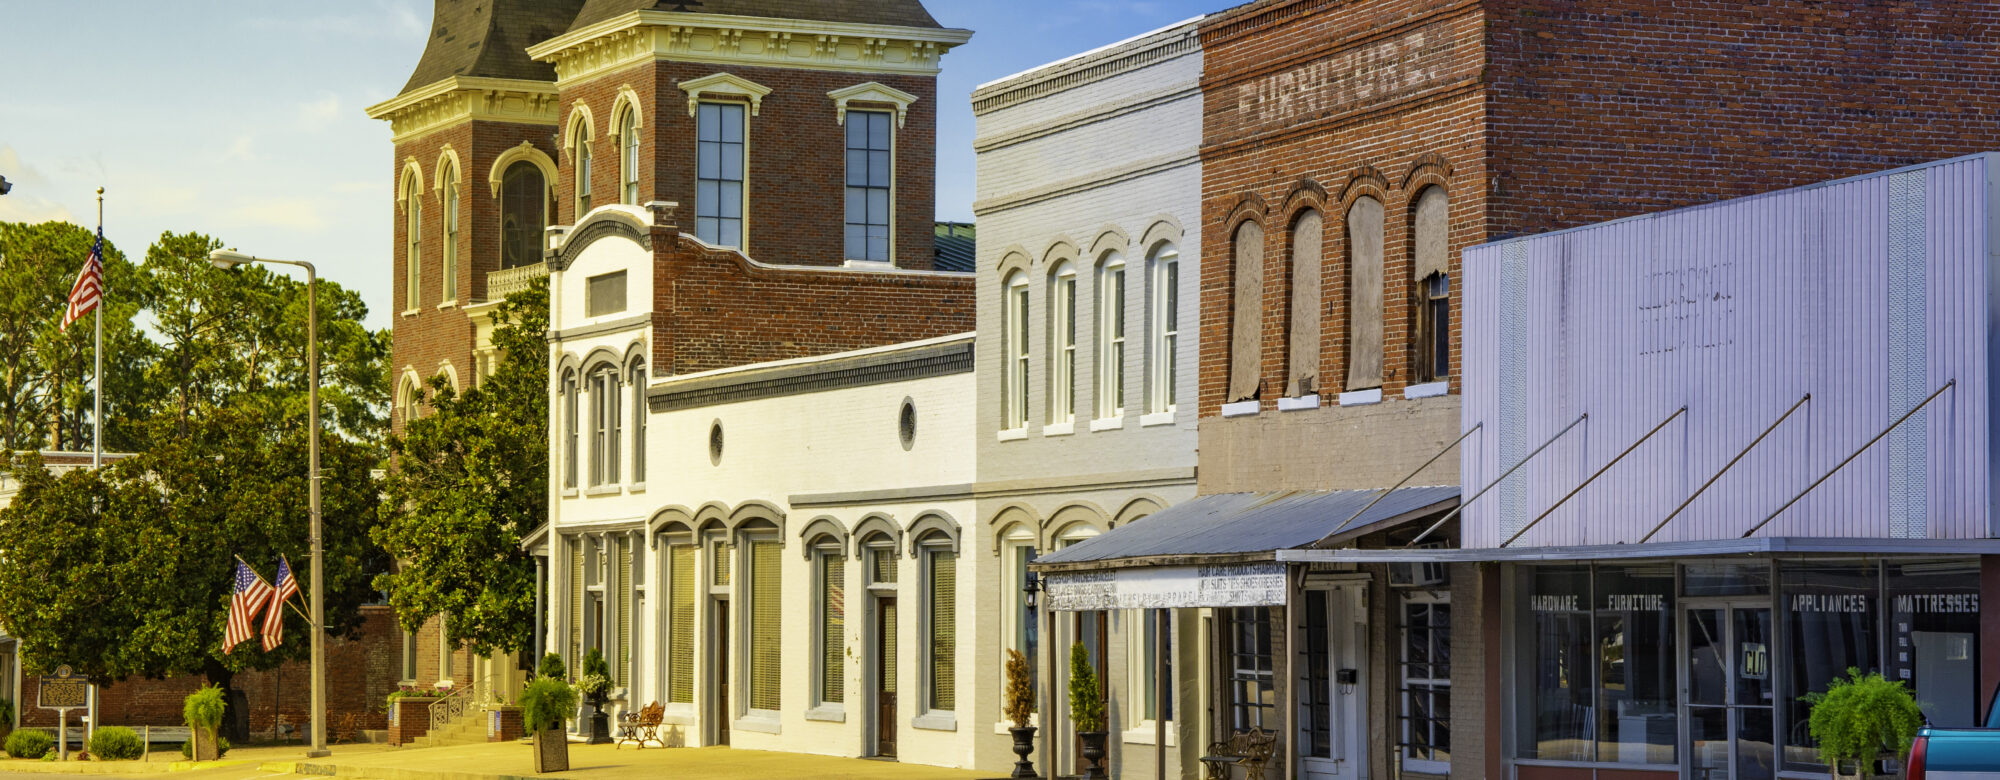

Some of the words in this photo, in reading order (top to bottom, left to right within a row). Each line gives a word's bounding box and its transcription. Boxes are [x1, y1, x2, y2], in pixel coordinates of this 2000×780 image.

[1531, 594, 1578, 611] HARDWARE
[1608, 594, 1663, 611] FURNITURE
[1791, 594, 1866, 613] APPLIANCES
[1897, 593, 1979, 613] MATTRESSES
